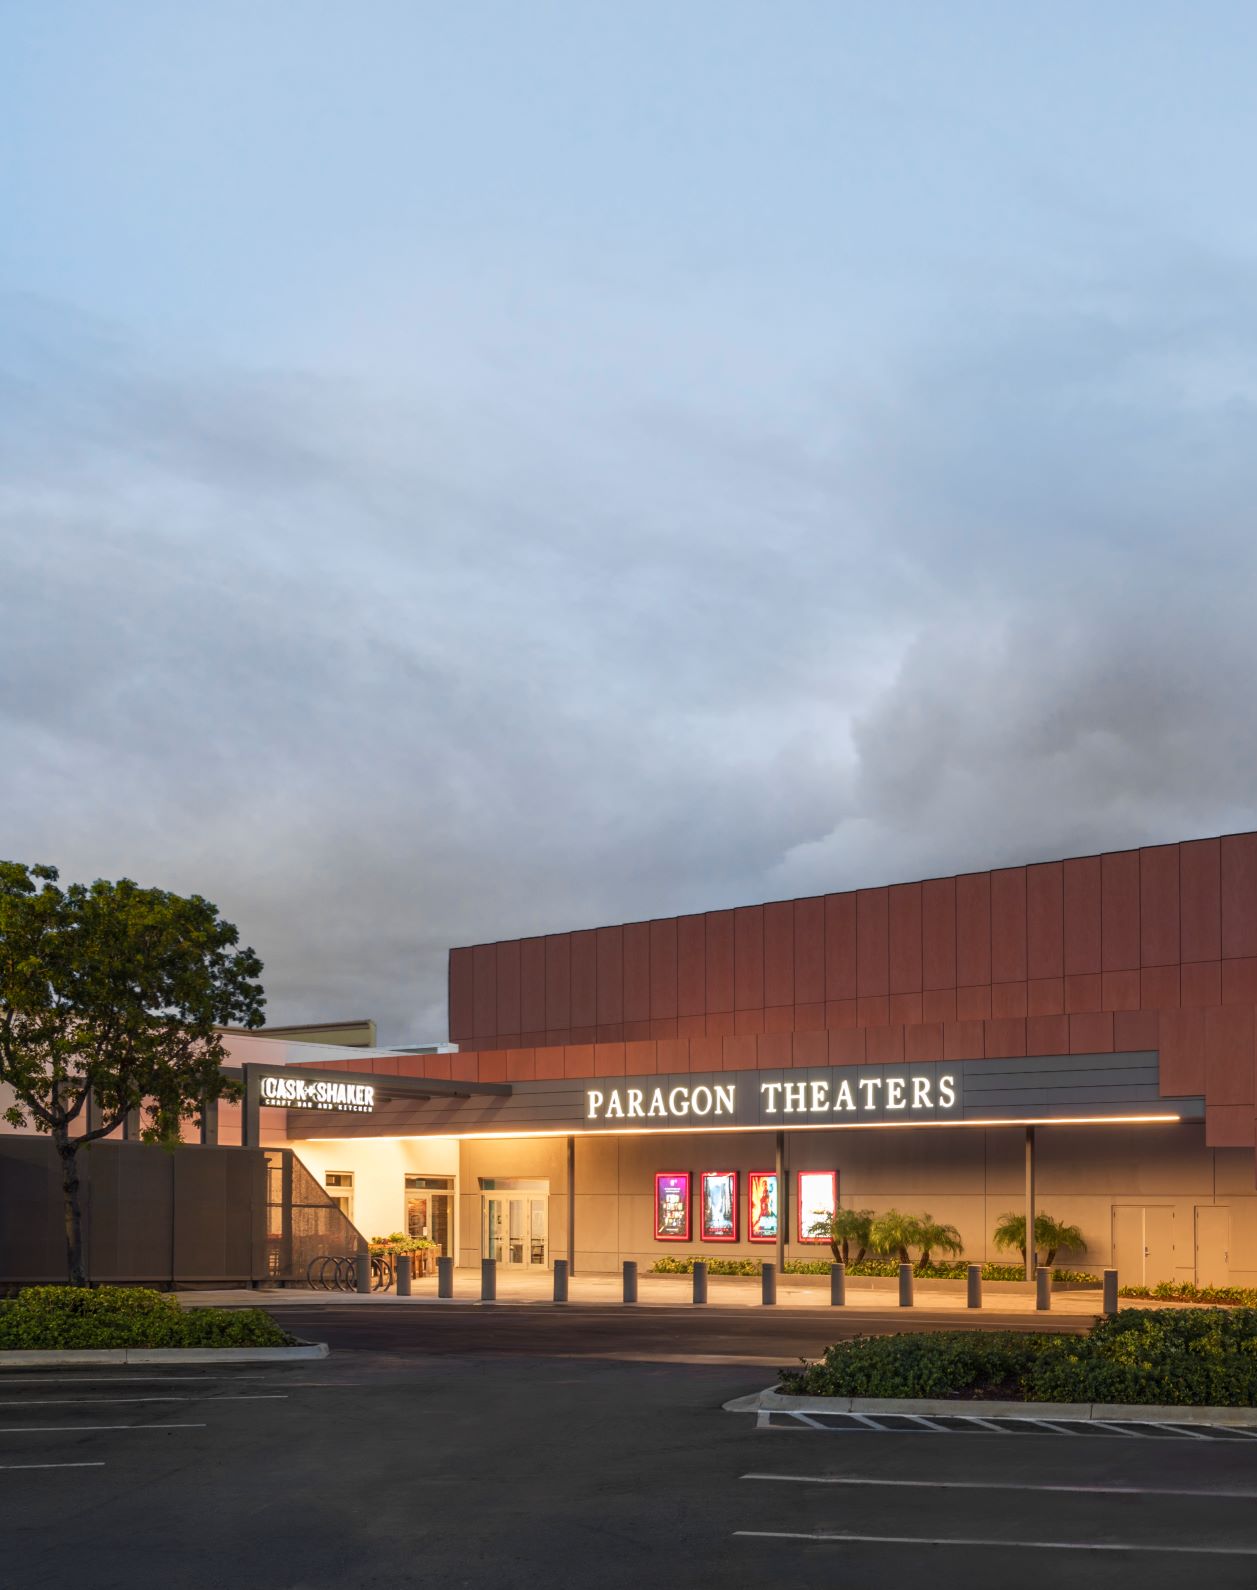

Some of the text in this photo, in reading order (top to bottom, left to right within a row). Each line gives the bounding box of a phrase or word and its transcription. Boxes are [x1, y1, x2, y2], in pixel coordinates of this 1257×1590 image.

[261, 1077, 375, 1106] CASK SHAKER
[265, 1099, 292, 1107] CRAFT
[297, 1101, 313, 1109] BAR
[338, 1105, 373, 1113] KITCHEN
[587, 1076, 956, 1119] PARAGON THEATERS
